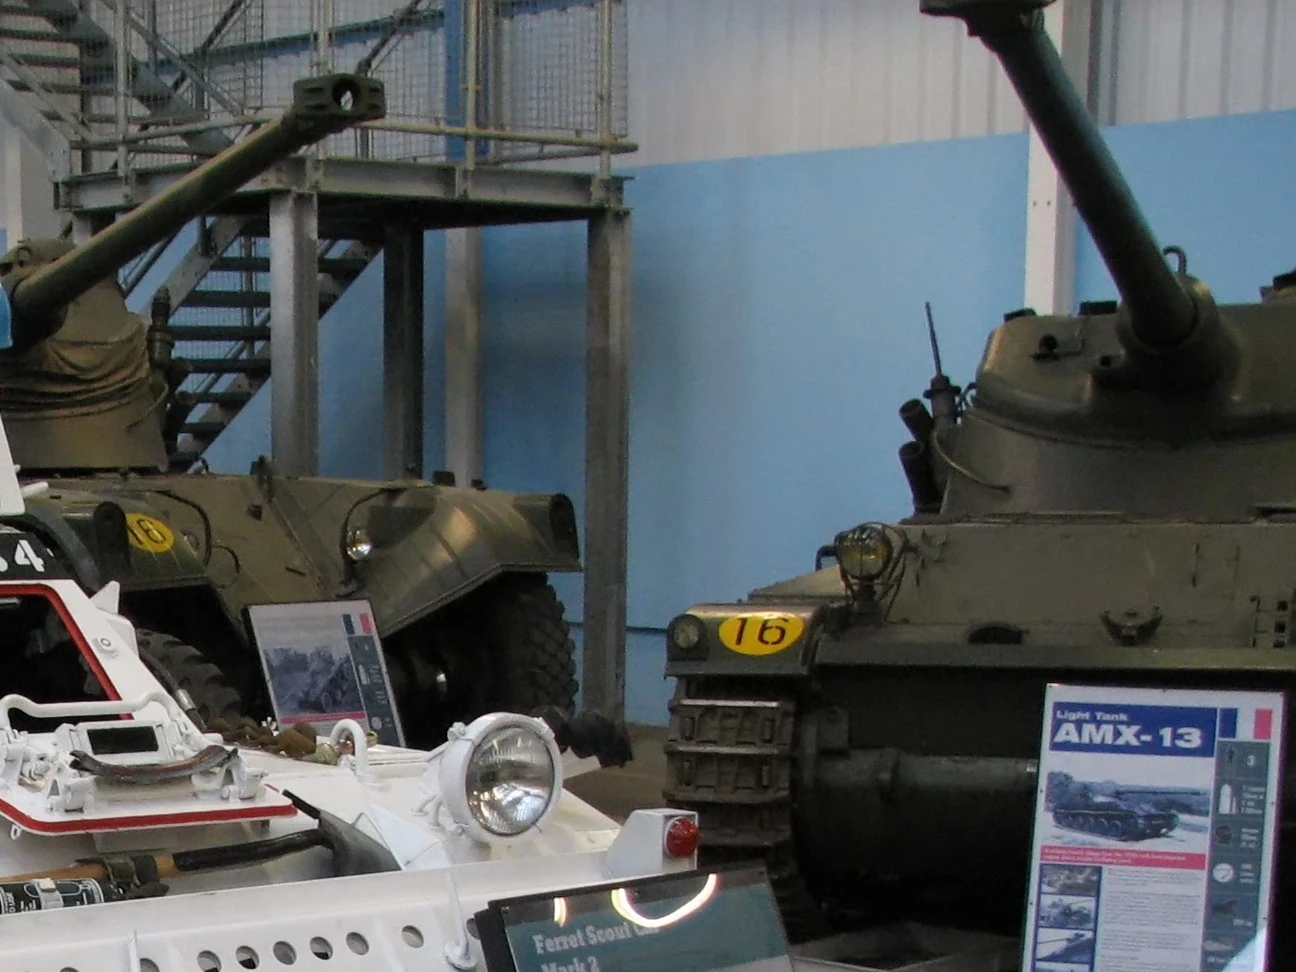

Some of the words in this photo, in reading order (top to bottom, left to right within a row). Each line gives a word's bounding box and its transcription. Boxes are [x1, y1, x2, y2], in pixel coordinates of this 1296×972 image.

[736, 617, 789, 646] 16
[1056, 710, 1090, 721] Light
[1095, 711, 1129, 722] Tank
[532, 930, 586, 954] Ferret
[585, 923, 633, 946] Scout
